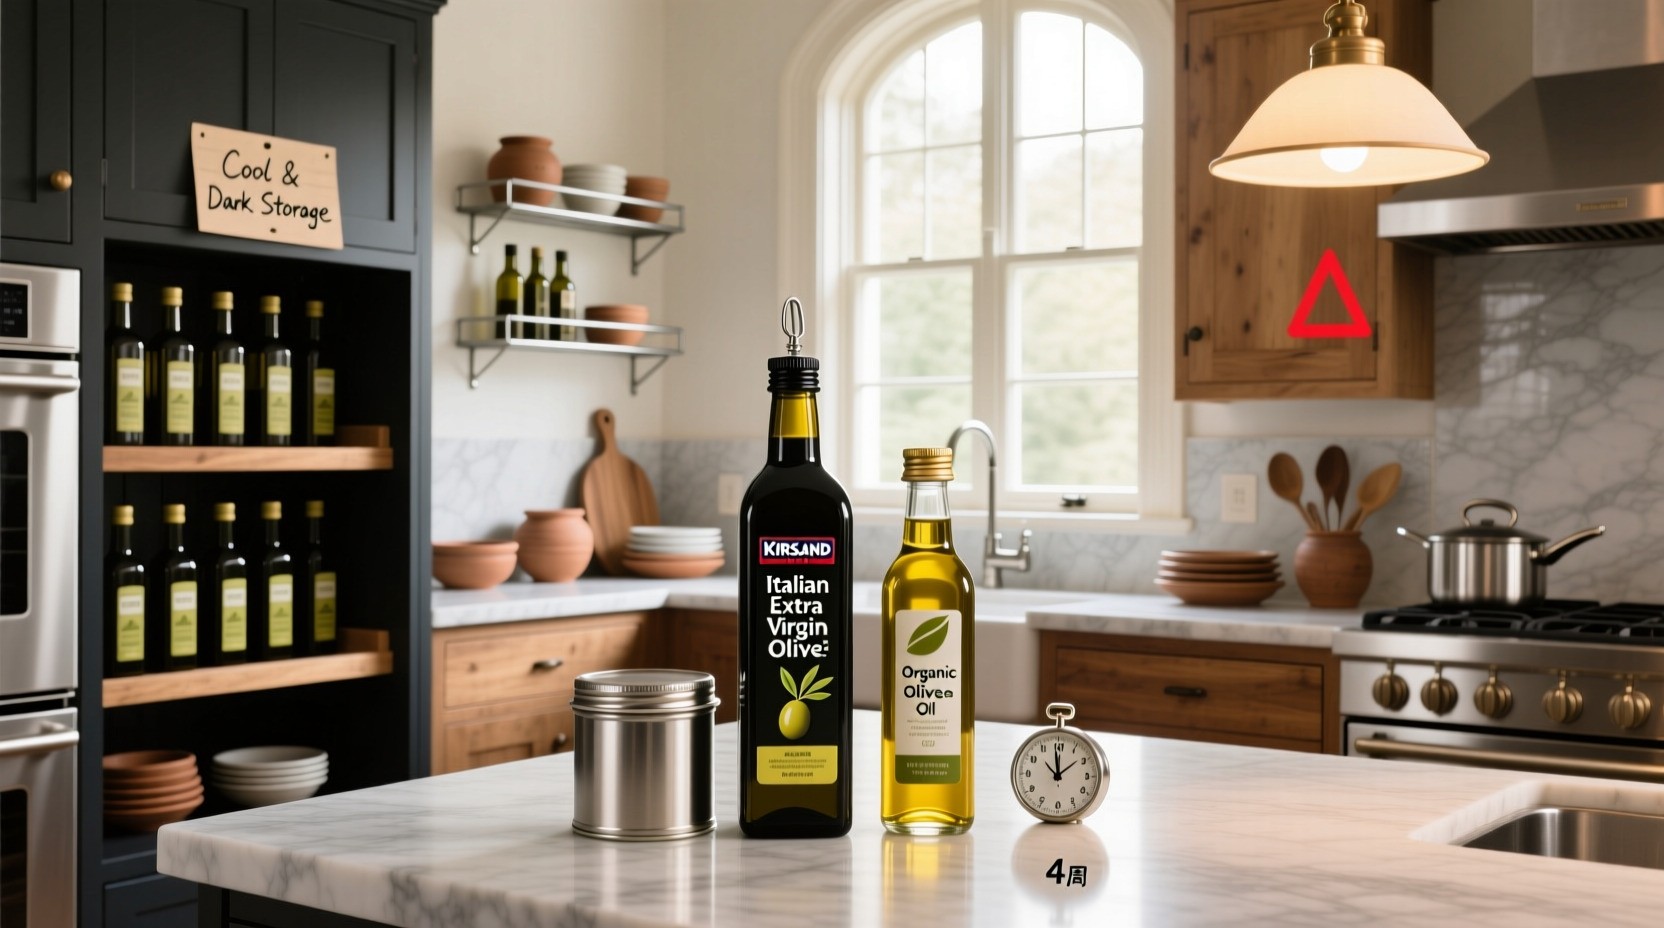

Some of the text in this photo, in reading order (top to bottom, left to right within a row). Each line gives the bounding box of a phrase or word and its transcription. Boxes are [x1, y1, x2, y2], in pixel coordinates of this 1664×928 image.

[222, 149, 299, 187] Cool &
[208, 184, 332, 230] Dark Storage
[766, 574, 829, 594] Italian
[770, 595, 823, 615] Extra
[766, 616, 828, 641] Virgin
[902, 665, 957, 683] Organic
